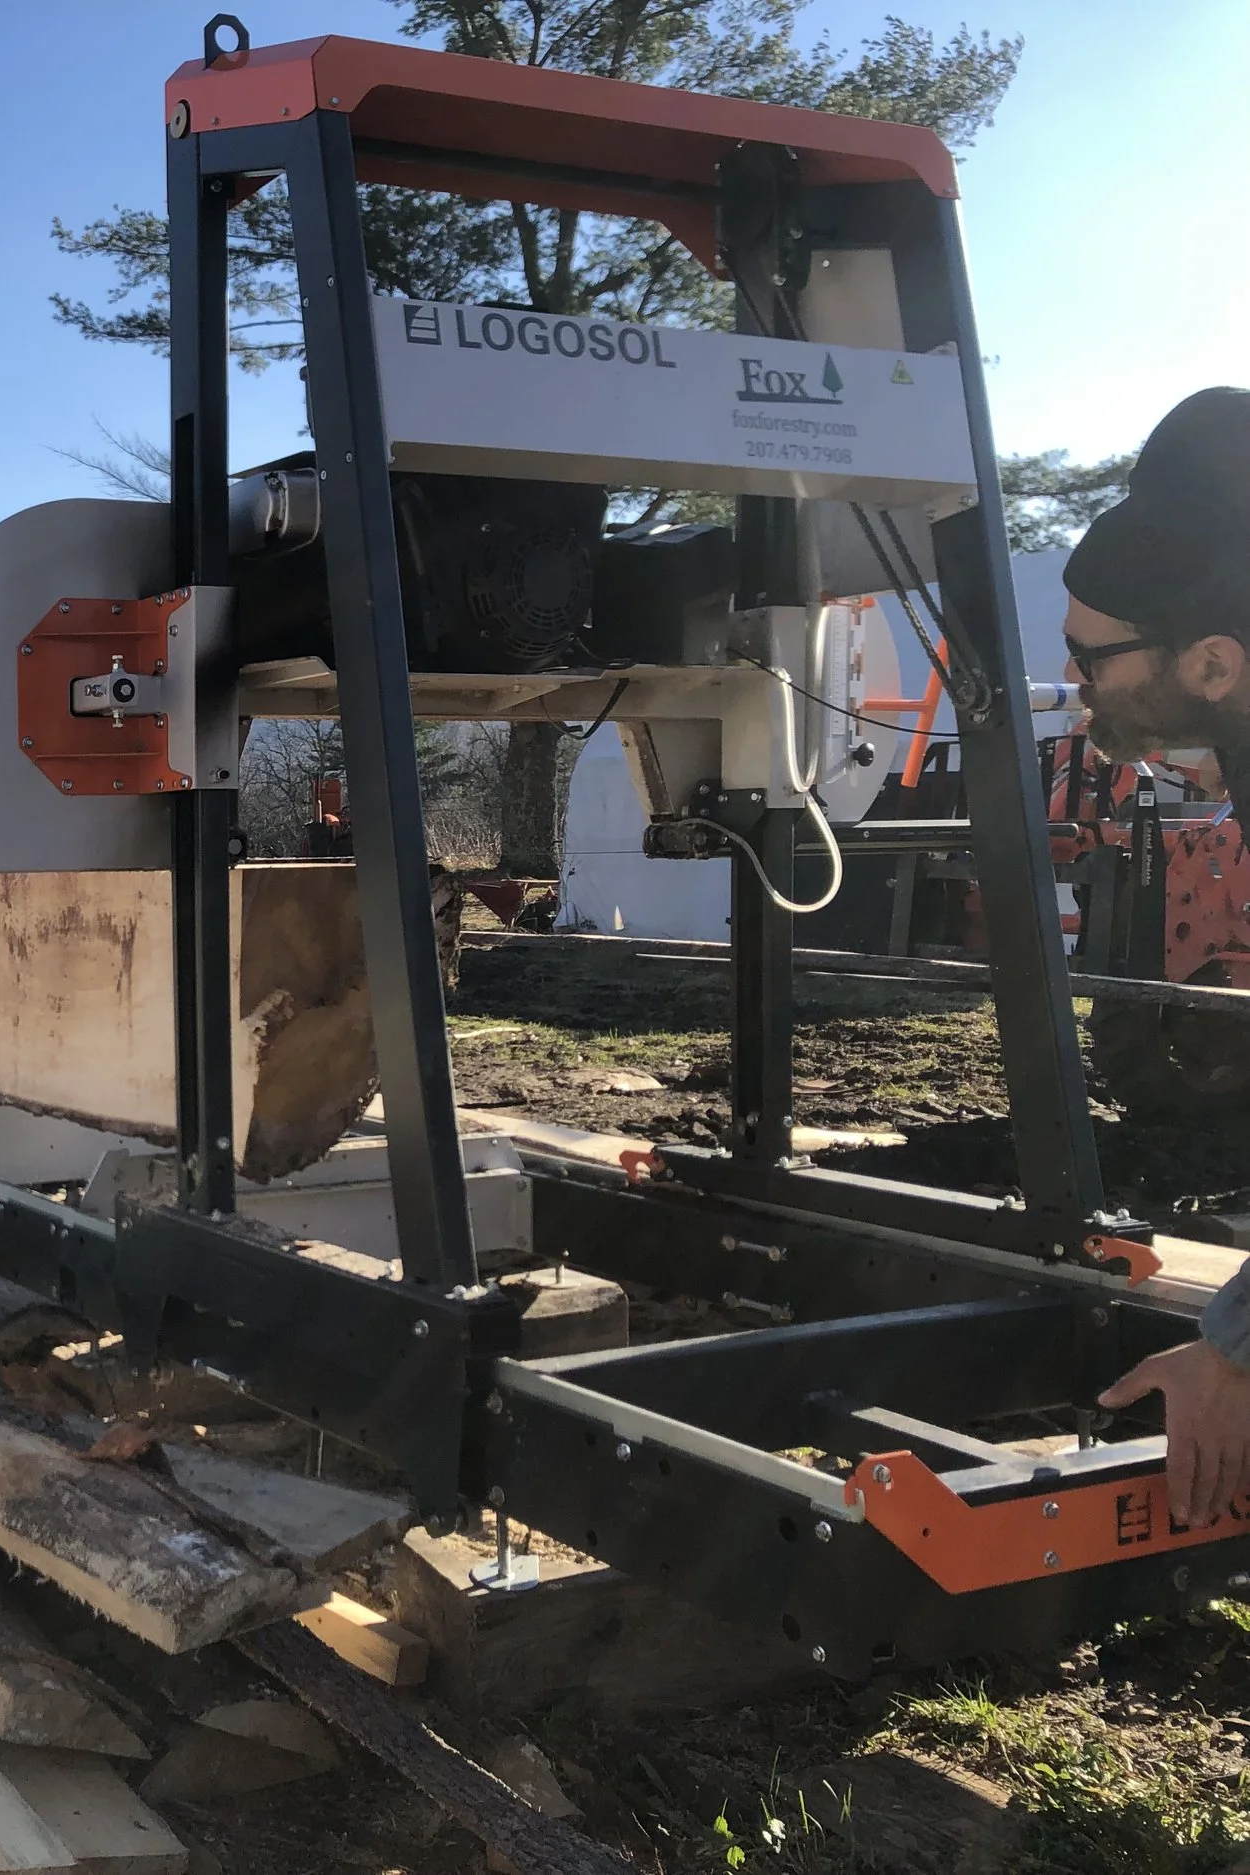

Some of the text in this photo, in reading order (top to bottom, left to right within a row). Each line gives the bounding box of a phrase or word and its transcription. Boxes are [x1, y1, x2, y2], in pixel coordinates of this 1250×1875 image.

[454, 308, 677, 368] LOGOSOL
[737, 357, 808, 398] Fox
[732, 408, 858, 439] foxforestry.com
